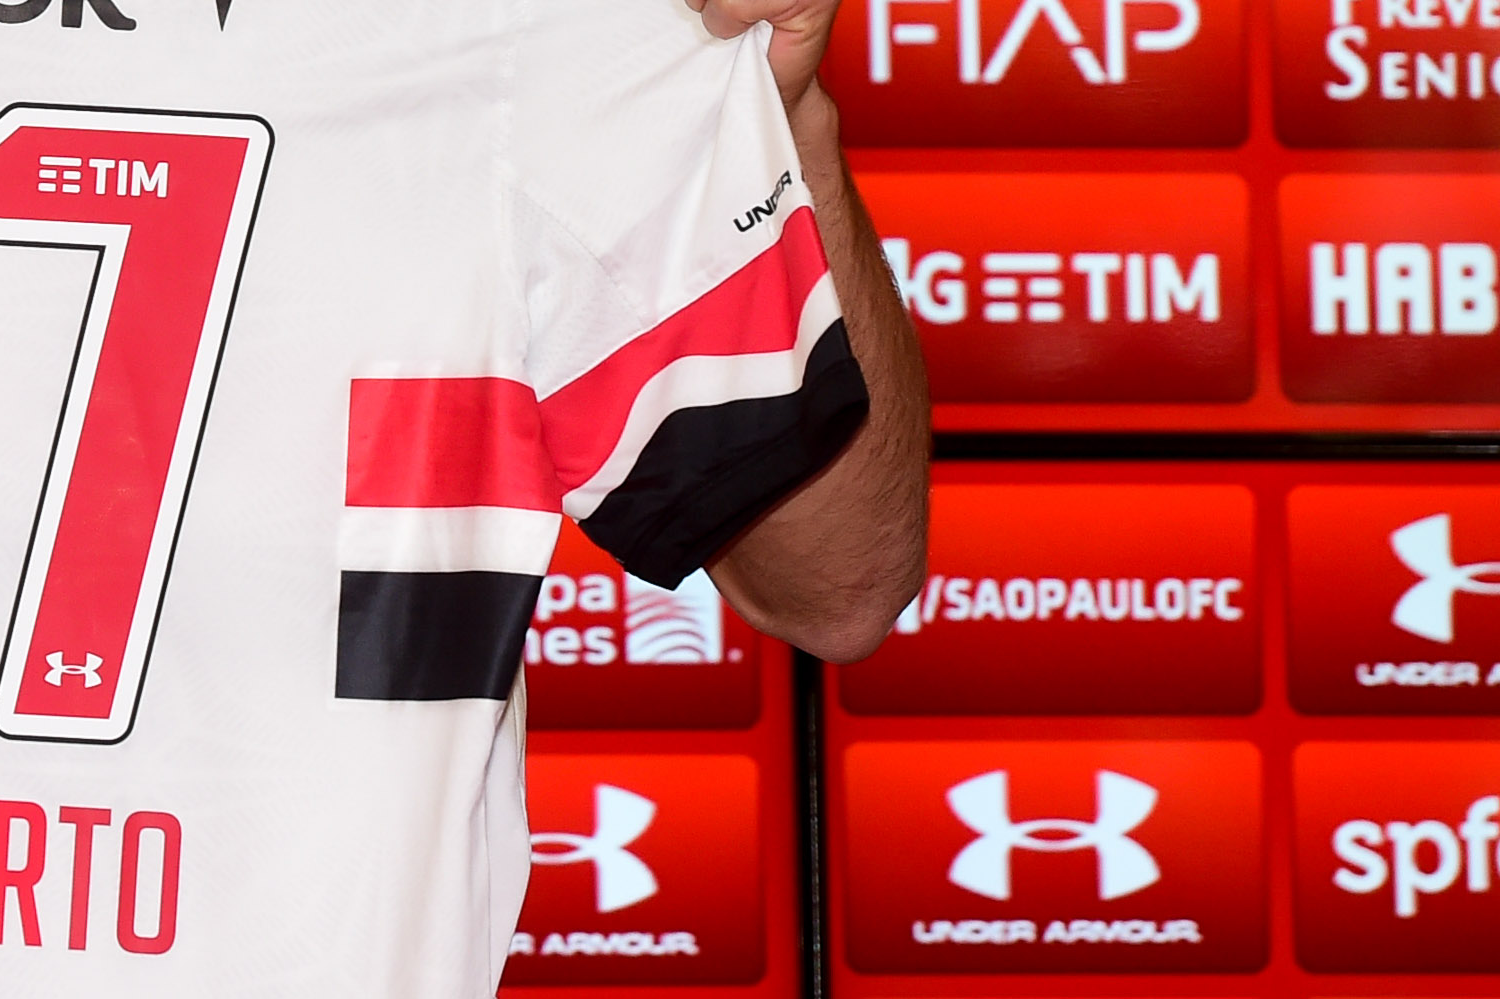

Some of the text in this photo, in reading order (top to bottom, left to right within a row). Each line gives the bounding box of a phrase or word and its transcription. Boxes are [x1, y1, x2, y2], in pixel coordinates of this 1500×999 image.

[1324, 25, 1500, 100] SENI
[89, 159, 169, 199] TIM
[1072, 253, 1219, 322] TIM
[923, 577, 1243, 621] /SAOPAULOFC
[1358, 663, 1478, 685] UNDER
[542, 932, 698, 955] ARMOUR
[913, 920, 1201, 943] UNDER ARMOUR
